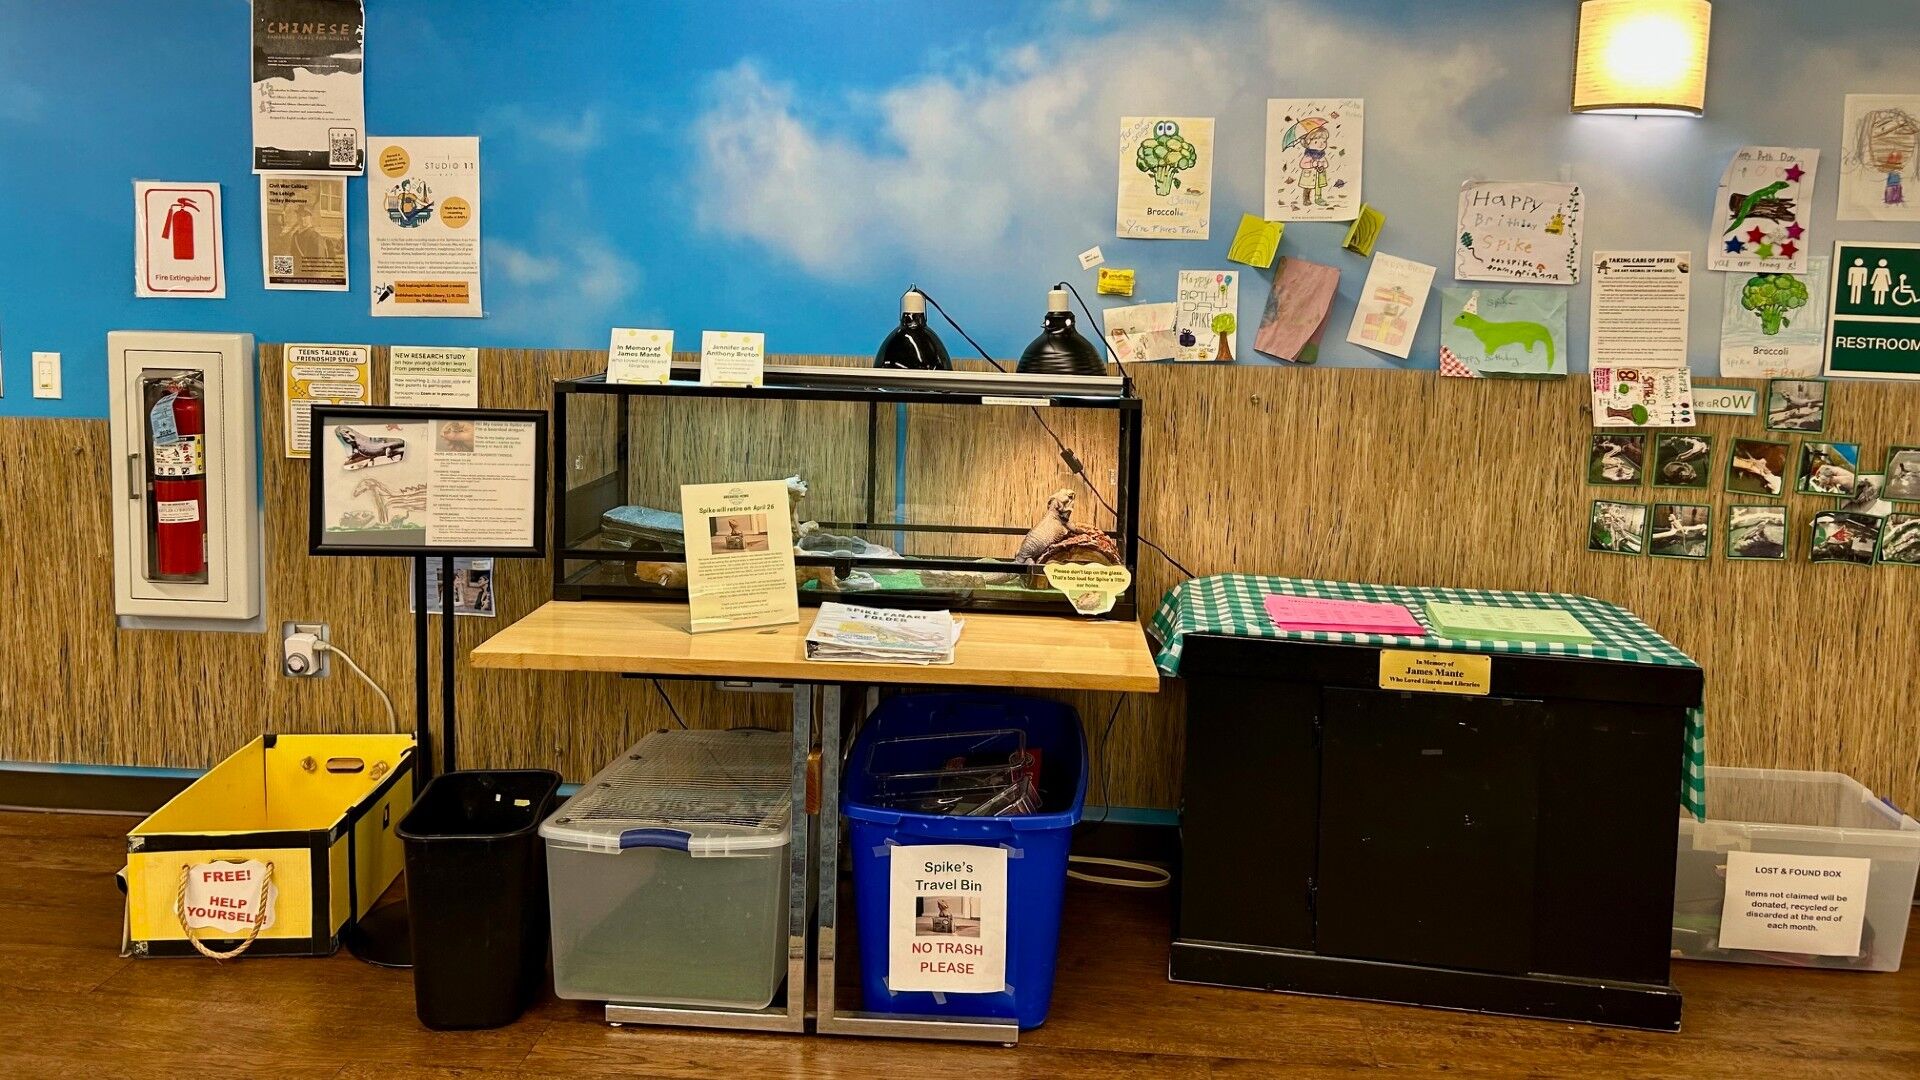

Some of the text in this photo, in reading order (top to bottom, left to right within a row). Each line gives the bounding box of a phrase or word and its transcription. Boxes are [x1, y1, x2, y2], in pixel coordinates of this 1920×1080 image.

[268, 22, 350, 35] CHINESE
[424, 162, 474, 170] STUDIO 11
[1473, 191, 1543, 213] Happy
[1483, 234, 1532, 253] Spike
[170, 274, 211, 282] Extinguisher
[1181, 273, 1212, 288] Happy
[1181, 290, 1216, 301] BIRTH
[1753, 346, 1789, 356] Broccoli
[847, 607, 879, 615] SPIKE
[864, 614, 907, 623] FOLDER
[1405, 667, 1464, 678] James Mante
[924, 861, 973, 874] Spike's
[1789, 868, 1820, 877] FOUND
[204, 870, 251, 882] FREE!
[916, 879, 982, 891] Travel Bin
[210, 896, 247, 909] HELP
[1752, 901, 1788, 910] donated,
[1790, 904, 1827, 912] recycled
[1746, 911, 1788, 919] discarded
[912, 942, 983, 955] NO TRASH
[921, 962, 974, 974] PLEASE
